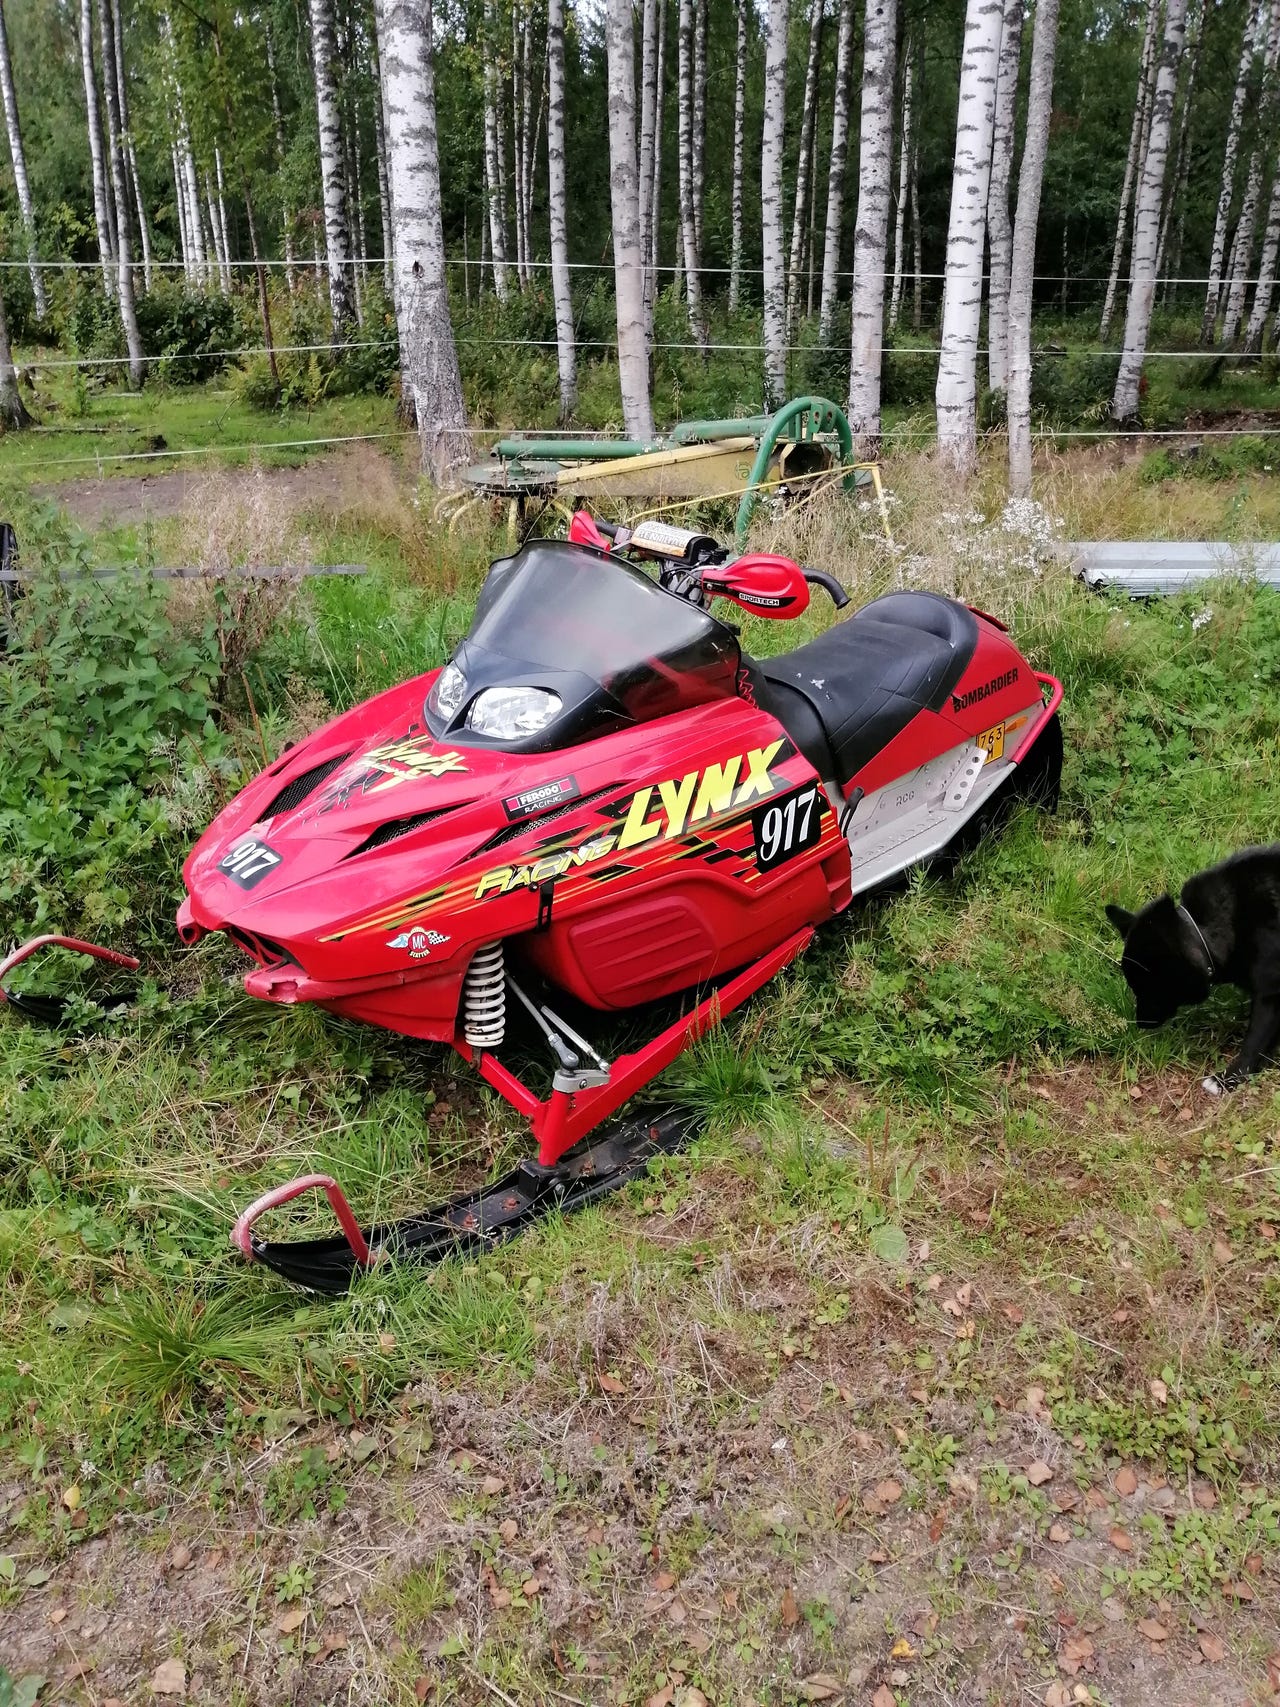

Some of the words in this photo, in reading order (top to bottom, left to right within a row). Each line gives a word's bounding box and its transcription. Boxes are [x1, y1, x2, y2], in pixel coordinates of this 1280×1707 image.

[739, 593, 779, 605] SPORTECH
[953, 668, 1018, 713] BOMBARDIER
[981, 727, 1002, 747] 763
[520, 785, 559, 805] FERODO
[524, 795, 562, 813] RACING
[617, 738, 786, 849] LYNX
[760, 788, 816, 861] 917
[222, 842, 280, 879] 917
[474, 835, 617, 899] RACING
[412, 935, 427, 949] MC
